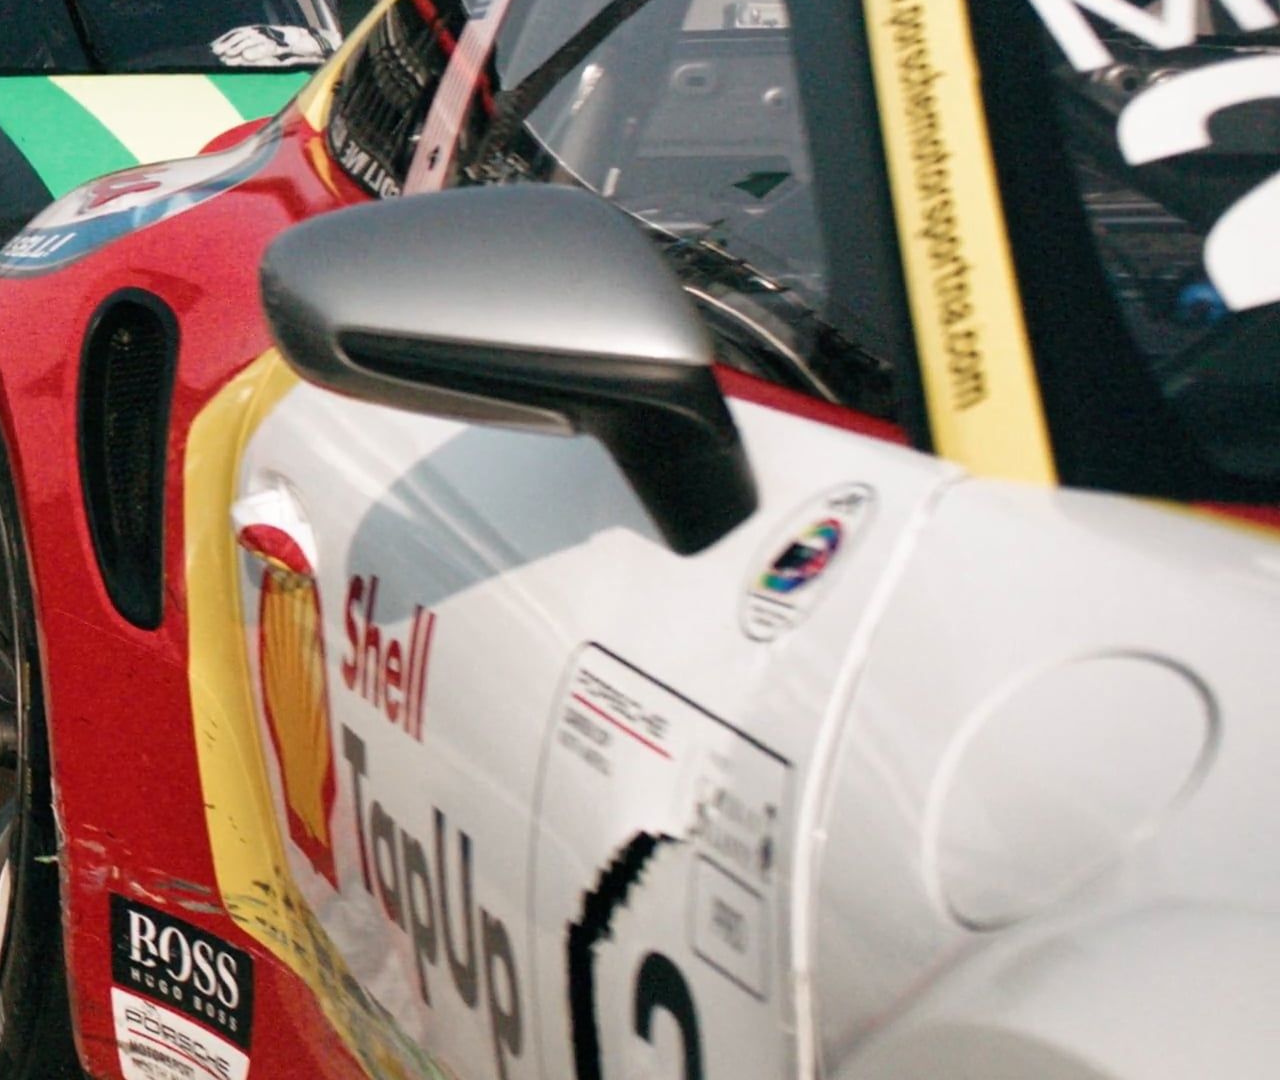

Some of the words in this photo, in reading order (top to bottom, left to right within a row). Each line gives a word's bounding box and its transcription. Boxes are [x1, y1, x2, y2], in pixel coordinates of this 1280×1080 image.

[341, 573, 437, 743] Shell
[341, 723, 524, 1080] TapUp
[127, 909, 240, 1010] BOSS
[129, 967, 184, 1001] HUGO
[192, 995, 239, 1032] BOSS
[125, 1007, 231, 1073] PORSCHE
